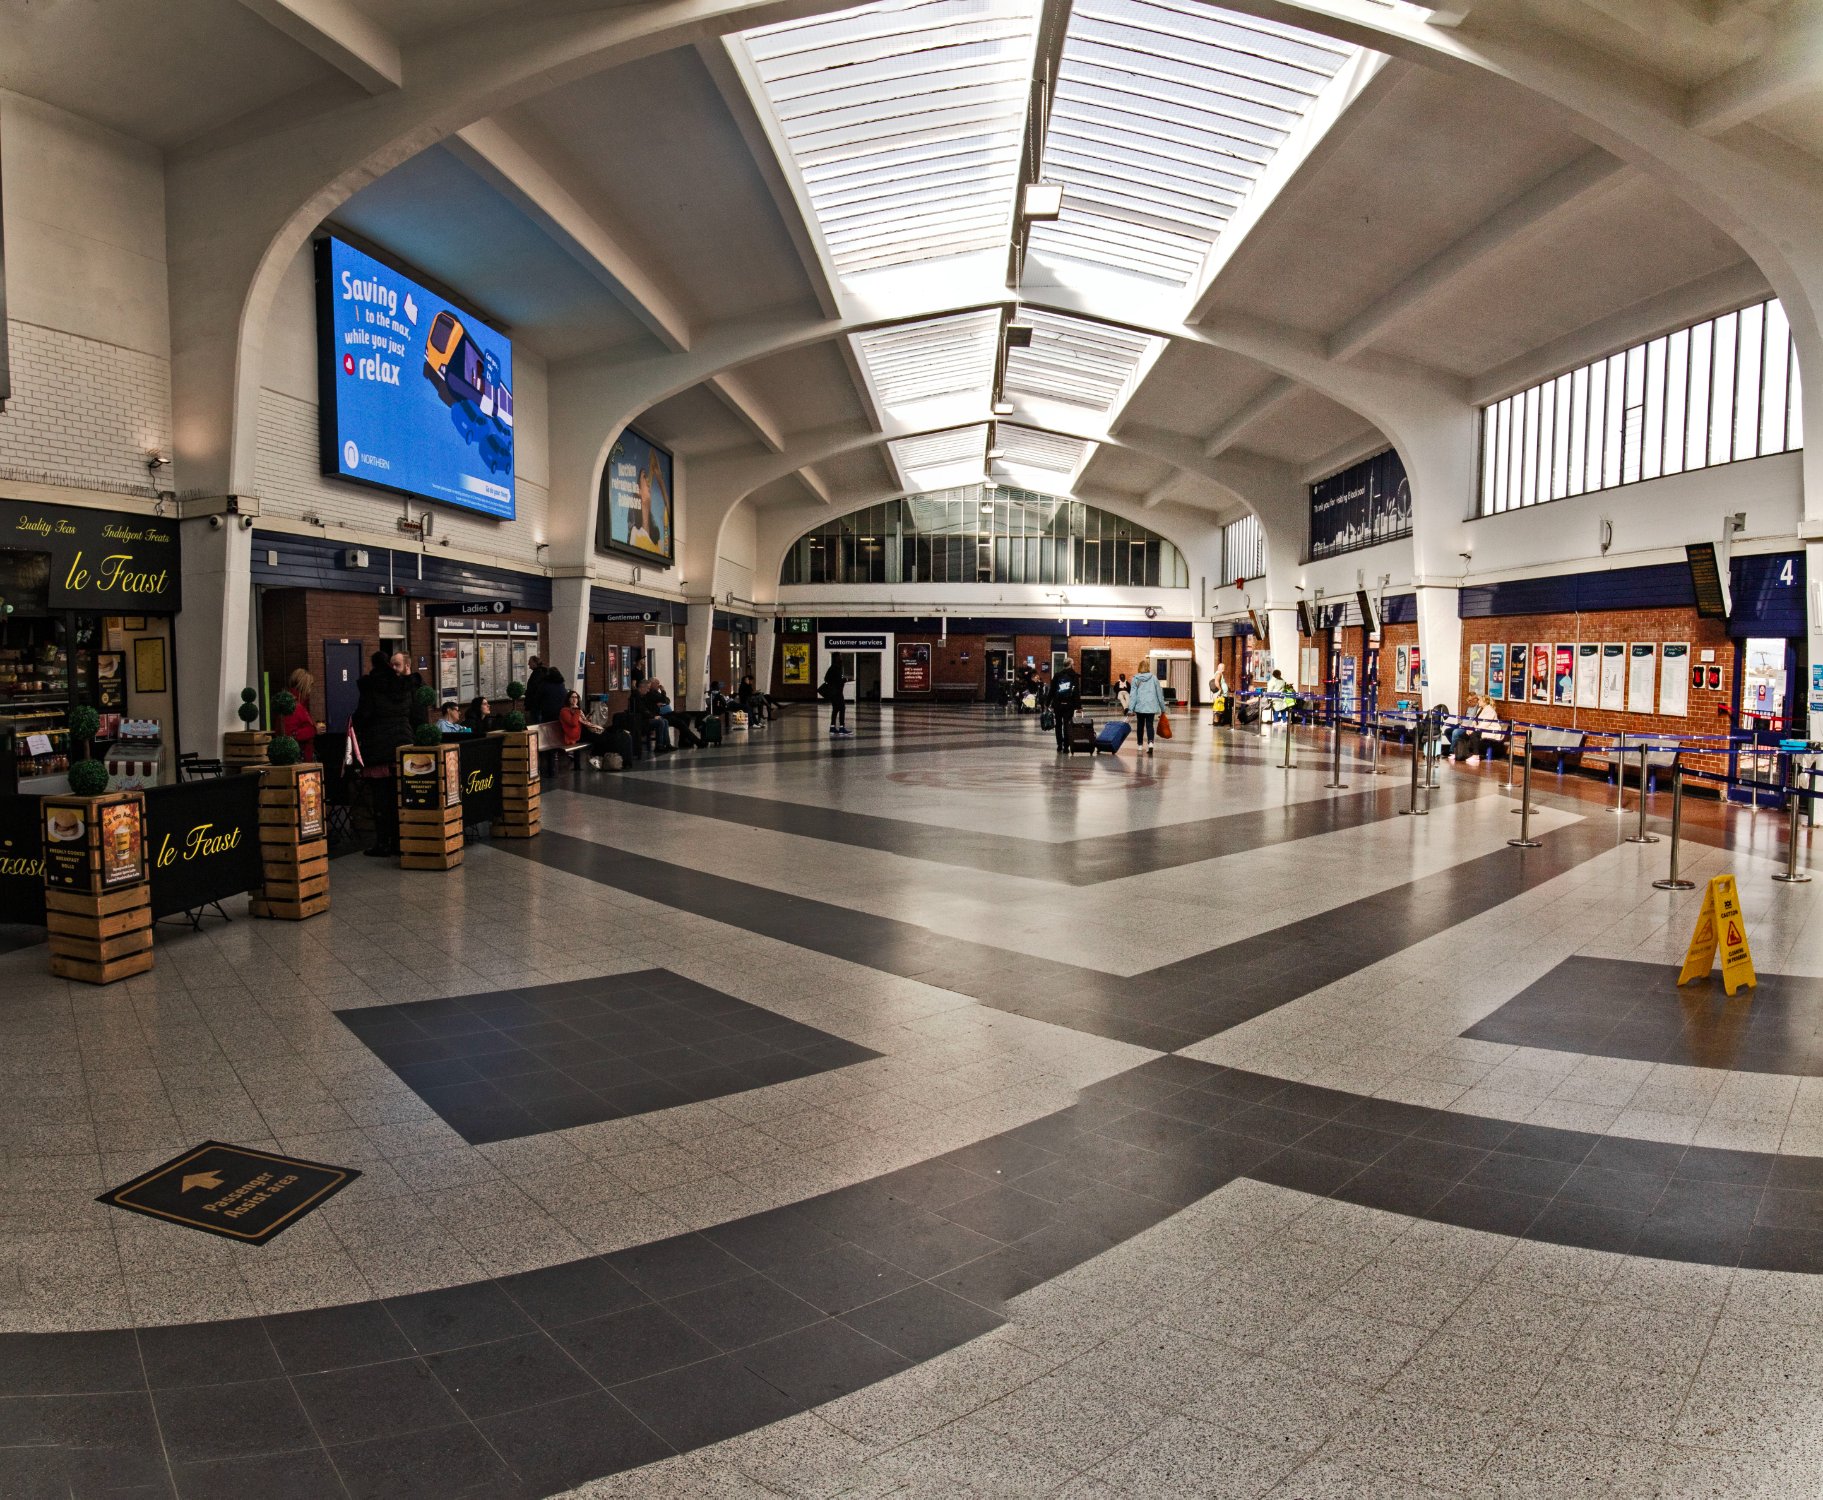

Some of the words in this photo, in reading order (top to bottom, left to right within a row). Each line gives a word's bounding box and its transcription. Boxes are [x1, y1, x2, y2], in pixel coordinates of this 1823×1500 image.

[341, 270, 398, 317] Saving
[365, 308, 376, 325] to
[376, 311, 391, 329] the
[391, 319, 412, 342] max,
[344, 328, 370, 346] while
[371, 333, 388, 350] you
[387, 336, 405, 358] just
[358, 352, 401, 386] relax
[360, 452, 391, 471] NORTHERN
[15, 515, 52, 537] Quality
[54, 519, 77, 535] Teas
[101, 524, 143, 544] Indulgent
[144, 528, 172, 543] Treats
[65, 551, 92, 590] le
[96, 554, 170, 594] Feast
[1780, 559, 1794, 586] 4
[462, 604, 488, 613] Ladies
[828, 638, 858, 647] Customer
[858, 638, 883, 647] services
[465, 769, 495, 795] Feast
[157, 833, 178, 868] le
[183, 823, 242, 860] Feast
[1720, 909, 1739, 919] CAUTION
[202, 1172, 274, 1212] Passenger
[223, 1192, 272, 1218] Assist
[266, 1174, 299, 1193] area
